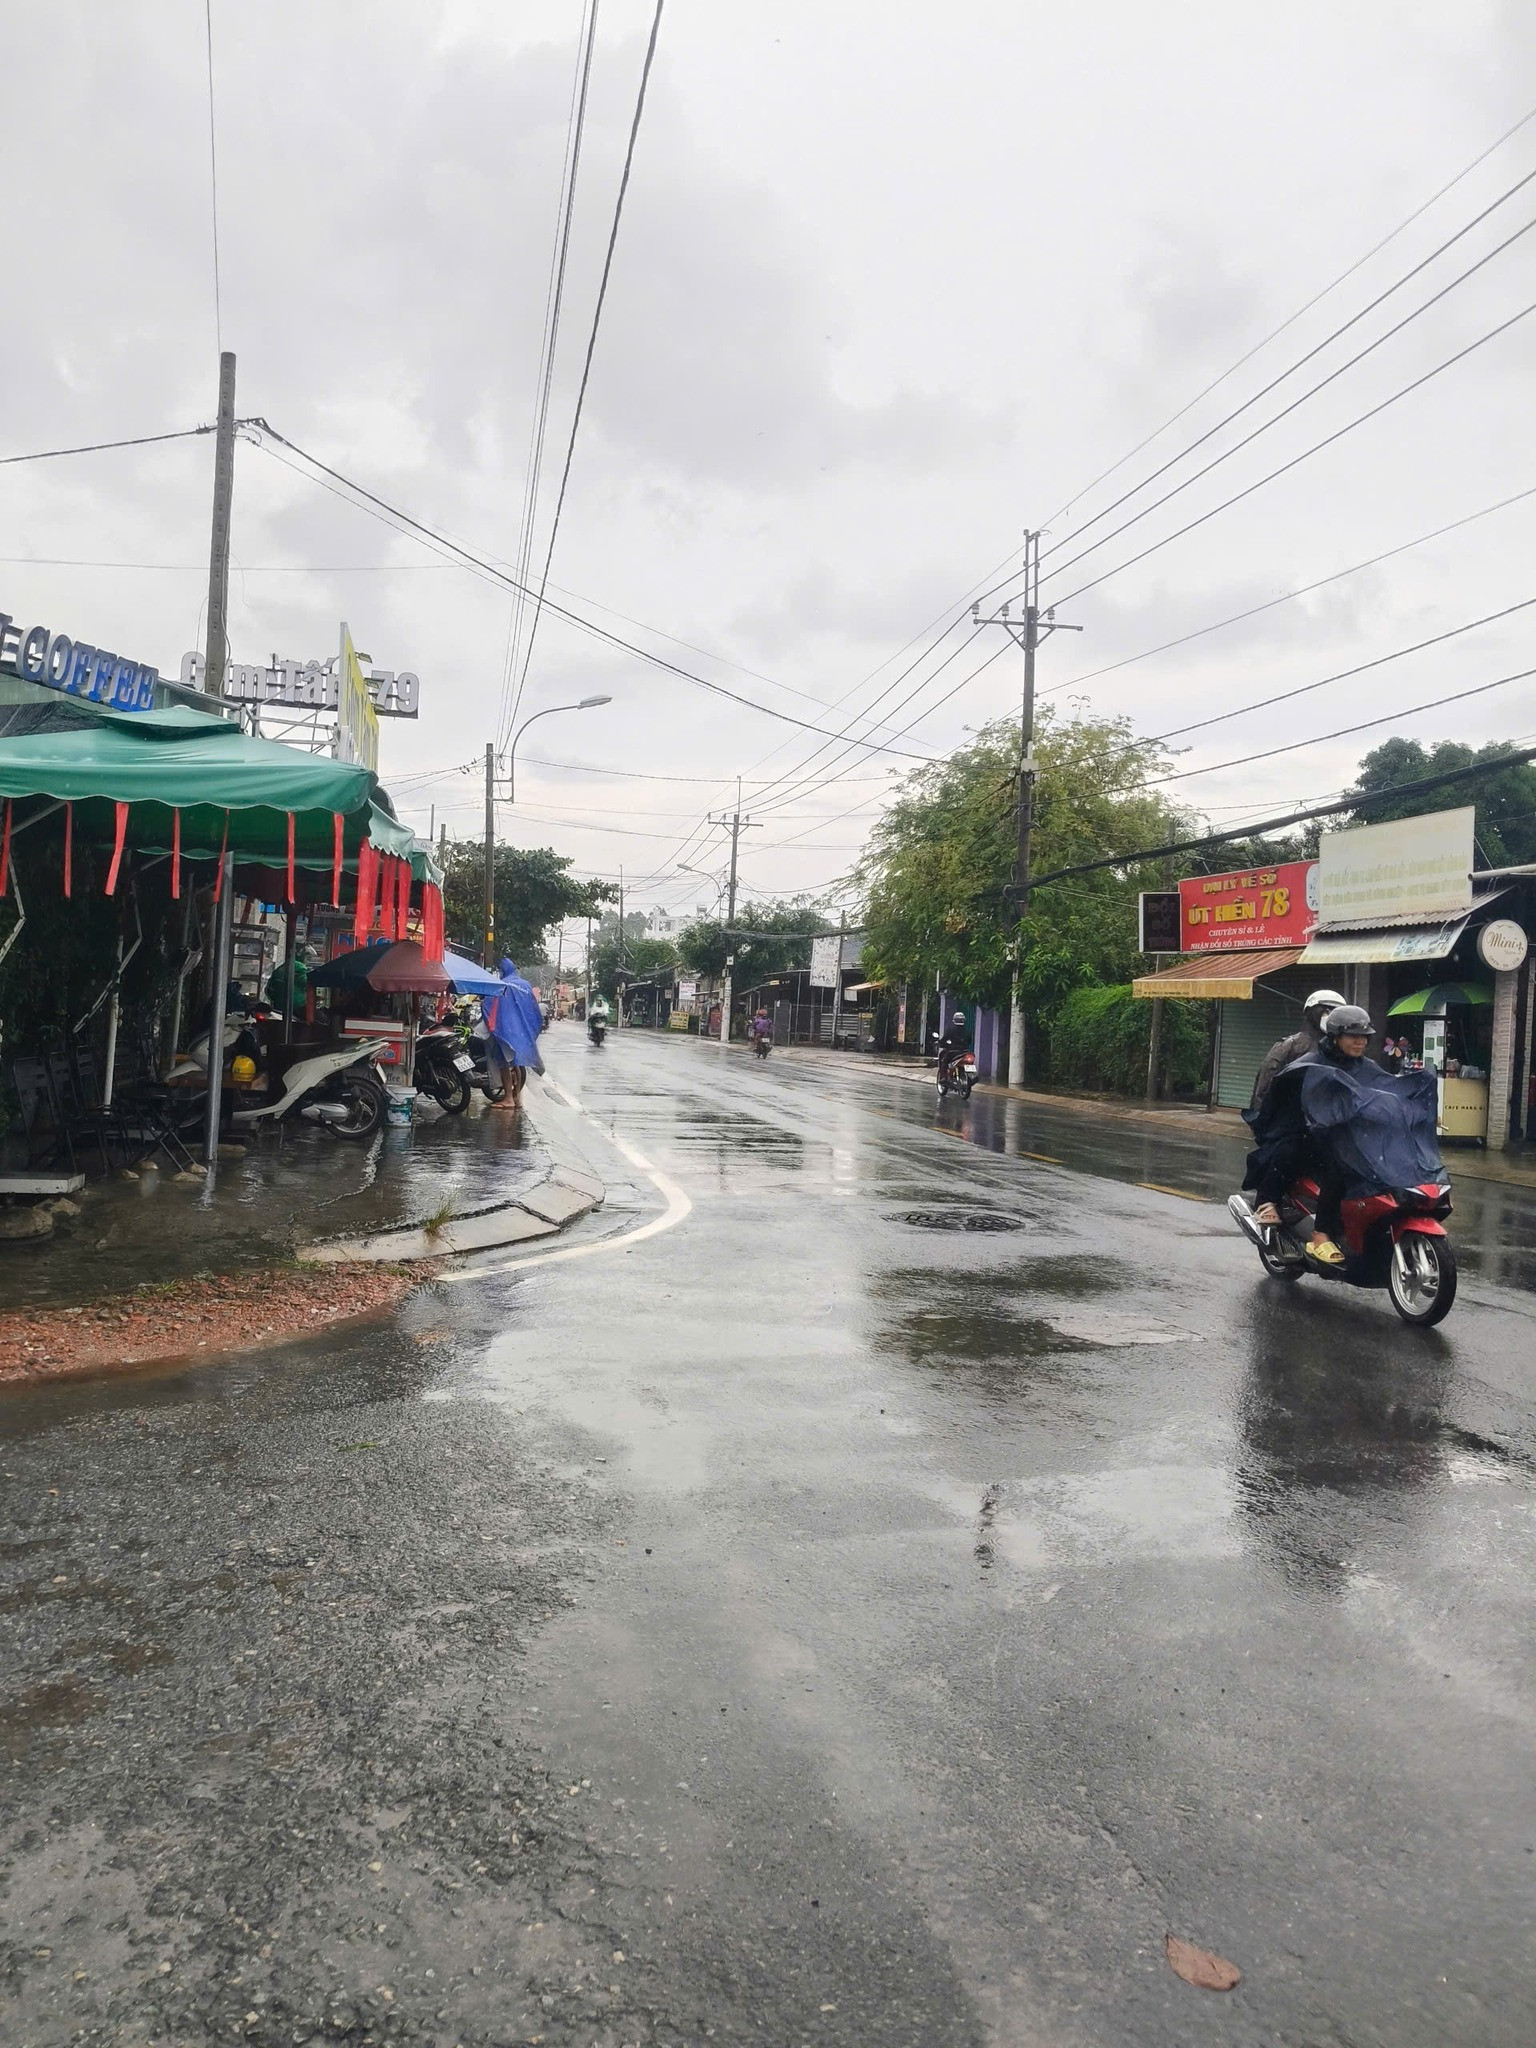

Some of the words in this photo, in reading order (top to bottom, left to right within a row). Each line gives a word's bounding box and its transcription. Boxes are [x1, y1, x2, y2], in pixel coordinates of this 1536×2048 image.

[16, 625, 159, 712] COFFEE
[371, 669, 420, 714] 79
[1260, 887, 1290, 918] 78
